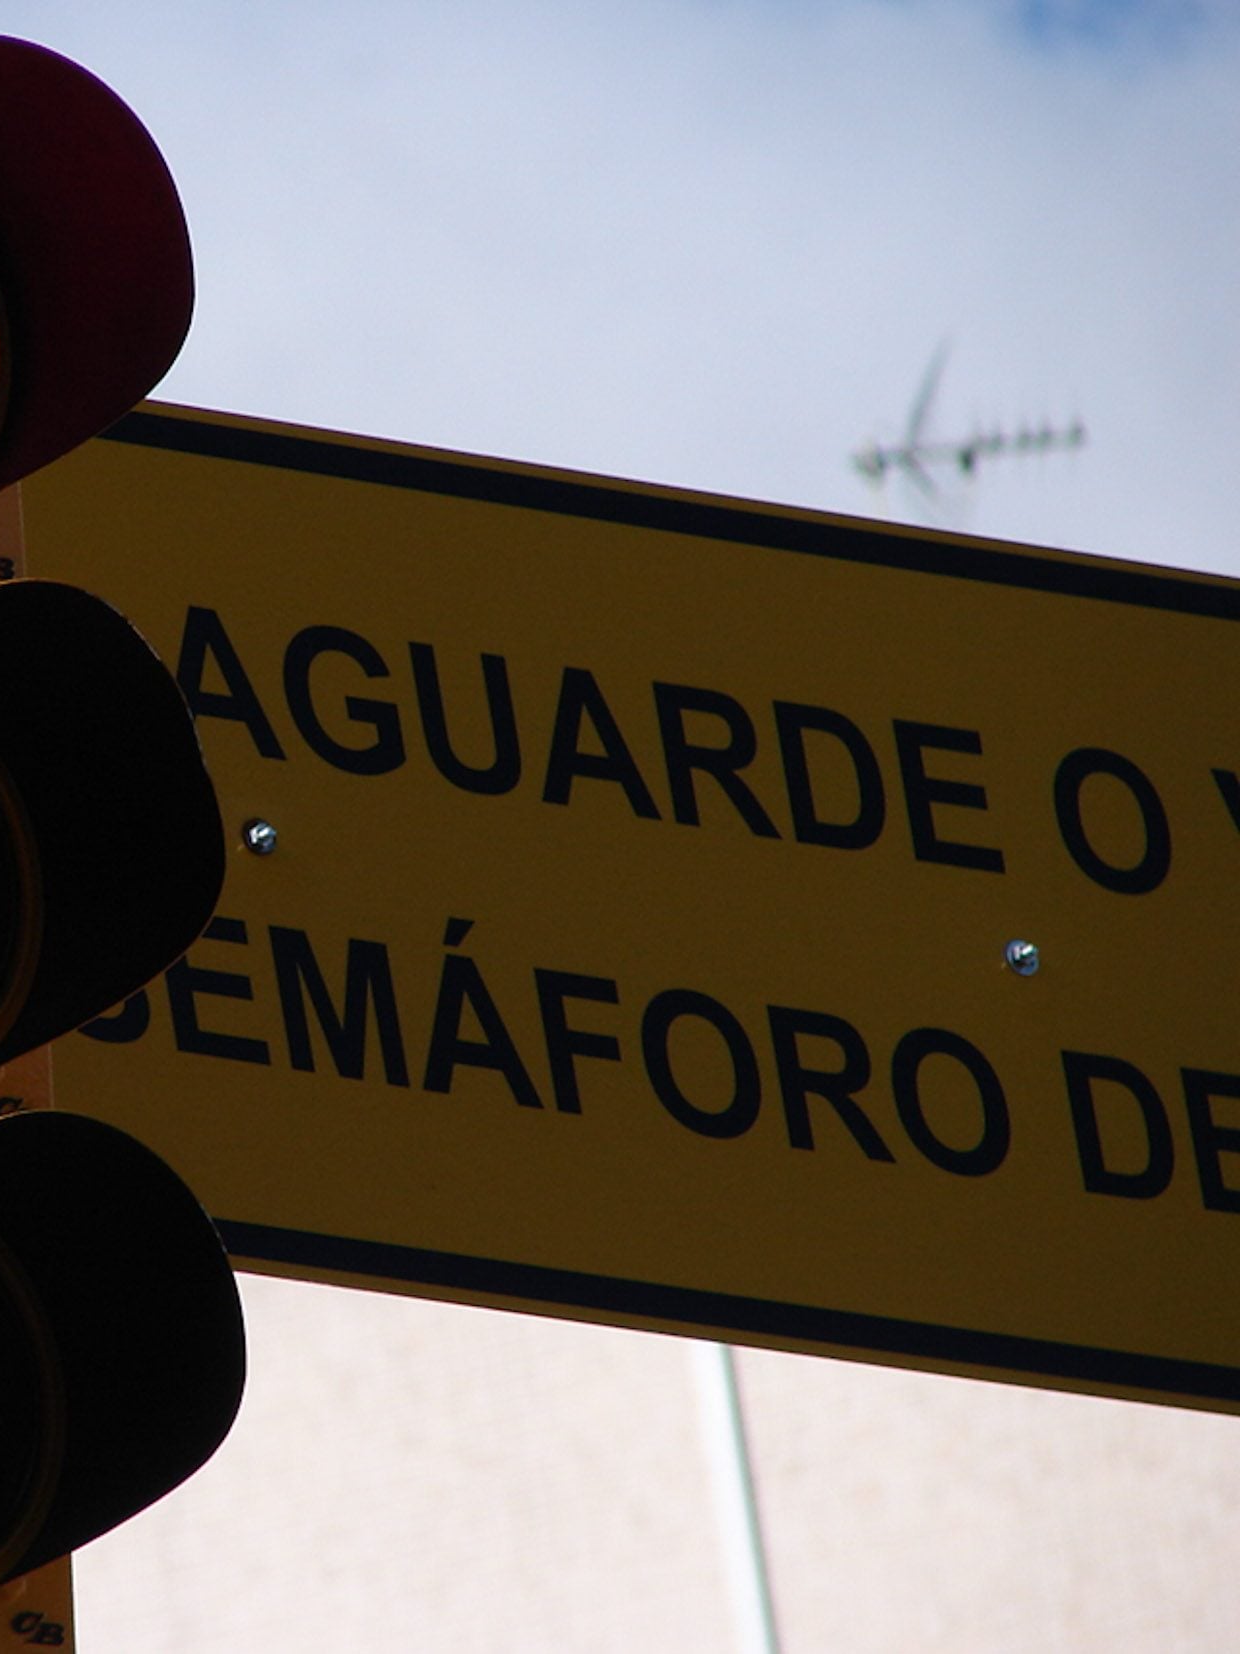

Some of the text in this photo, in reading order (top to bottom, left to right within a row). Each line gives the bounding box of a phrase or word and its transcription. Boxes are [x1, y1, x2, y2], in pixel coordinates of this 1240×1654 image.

[176, 605, 1172, 895] AGUARDE O
[78, 916, 1011, 1178] EMÁFORO
